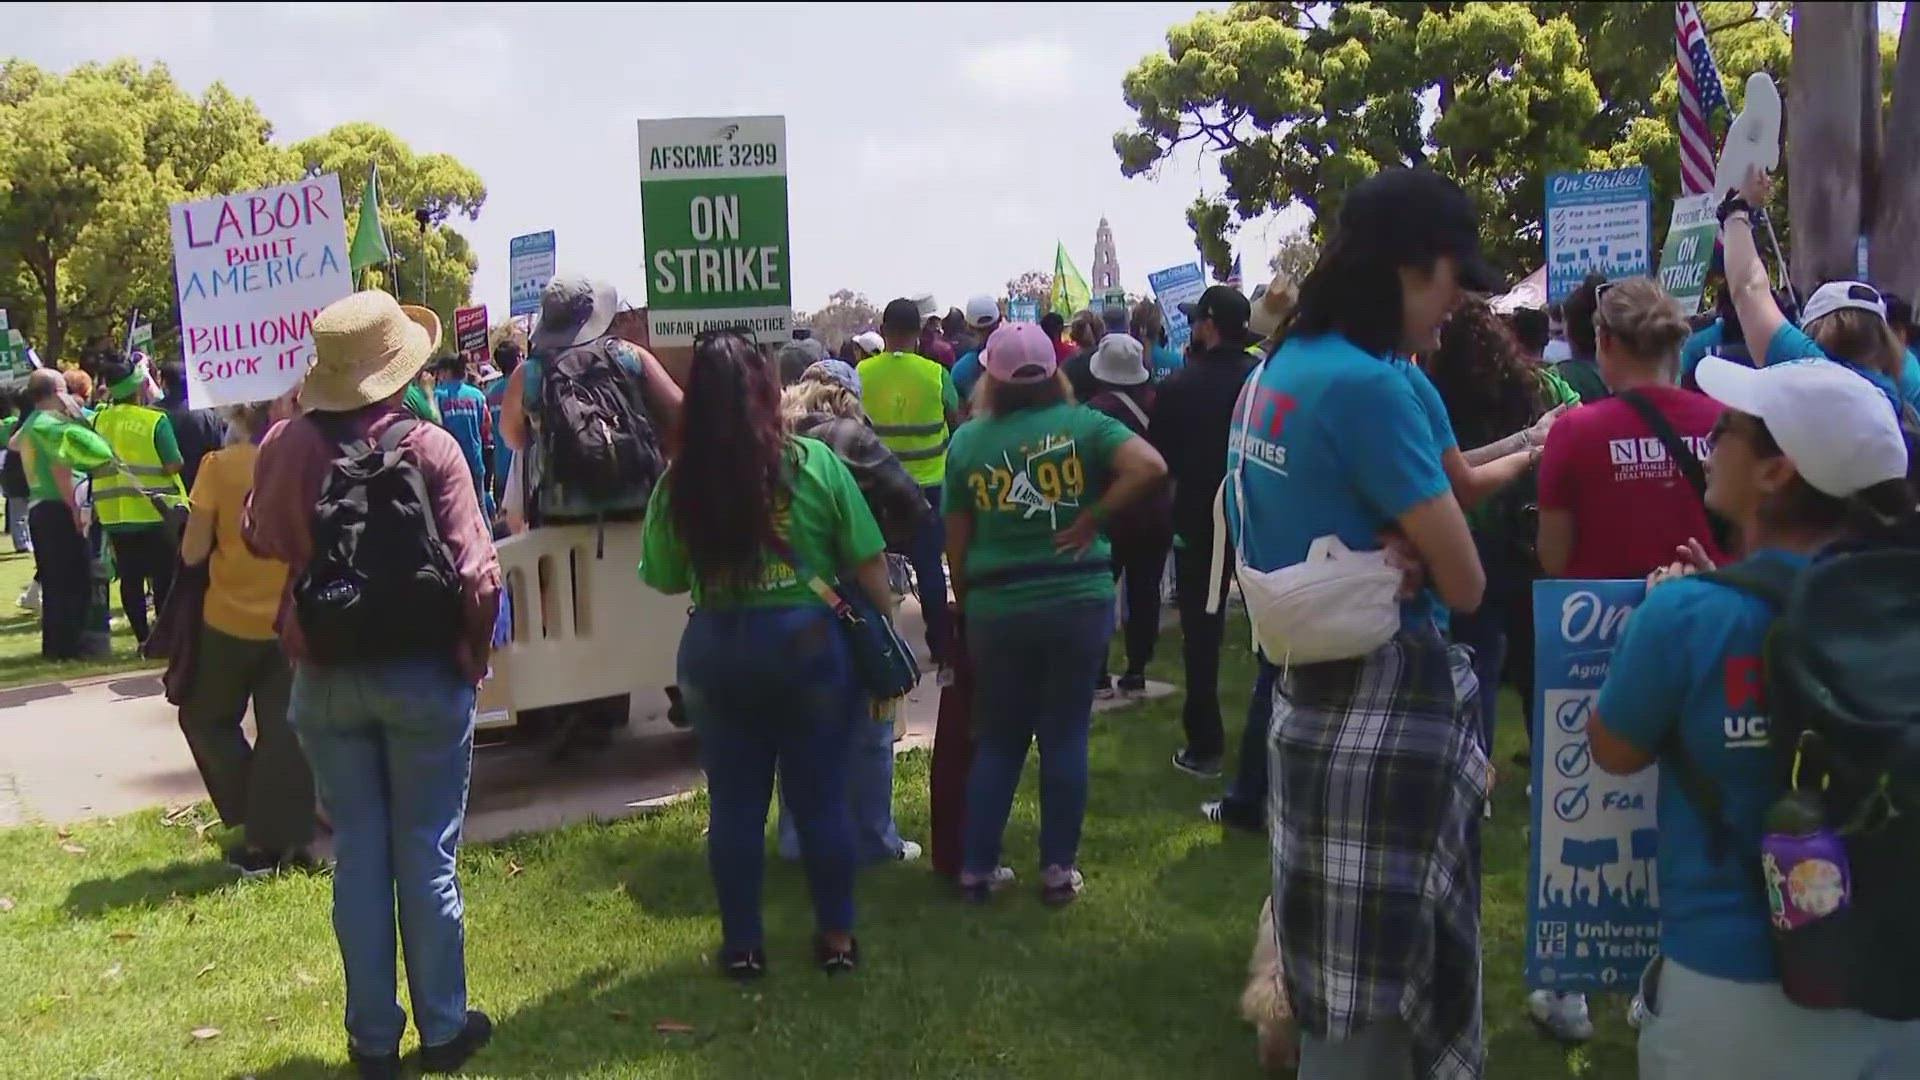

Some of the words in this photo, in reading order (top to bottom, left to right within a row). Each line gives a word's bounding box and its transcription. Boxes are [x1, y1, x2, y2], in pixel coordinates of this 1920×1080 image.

[650, 145, 724, 170] AFSCME
[730, 143, 777, 167] 3299
[1553, 176, 1581, 194] On
[1582, 168, 1644, 191] Strike!
[183, 184, 330, 249] LABOR
[690, 194, 739, 242] ON
[226, 236, 298, 267] BUILT
[1678, 235, 1699, 263] ON
[182, 244, 340, 301] AMERICA
[653, 245, 782, 294] STRIKE
[1660, 261, 1707, 291] STRIKE
[188, 308, 319, 355] BILLIONA
[655, 320, 695, 336] UNFAIR
[198, 355, 263, 383] SUCK
[279, 345, 303, 371] IT
[1614, 469, 1674, 482] HEALTHCARE
[1620, 461, 1666, 473] NATIONAL
[1560, 590, 1637, 643] On
[1602, 791, 1645, 811] FOR
[1596, 941, 1661, 958] Techn
